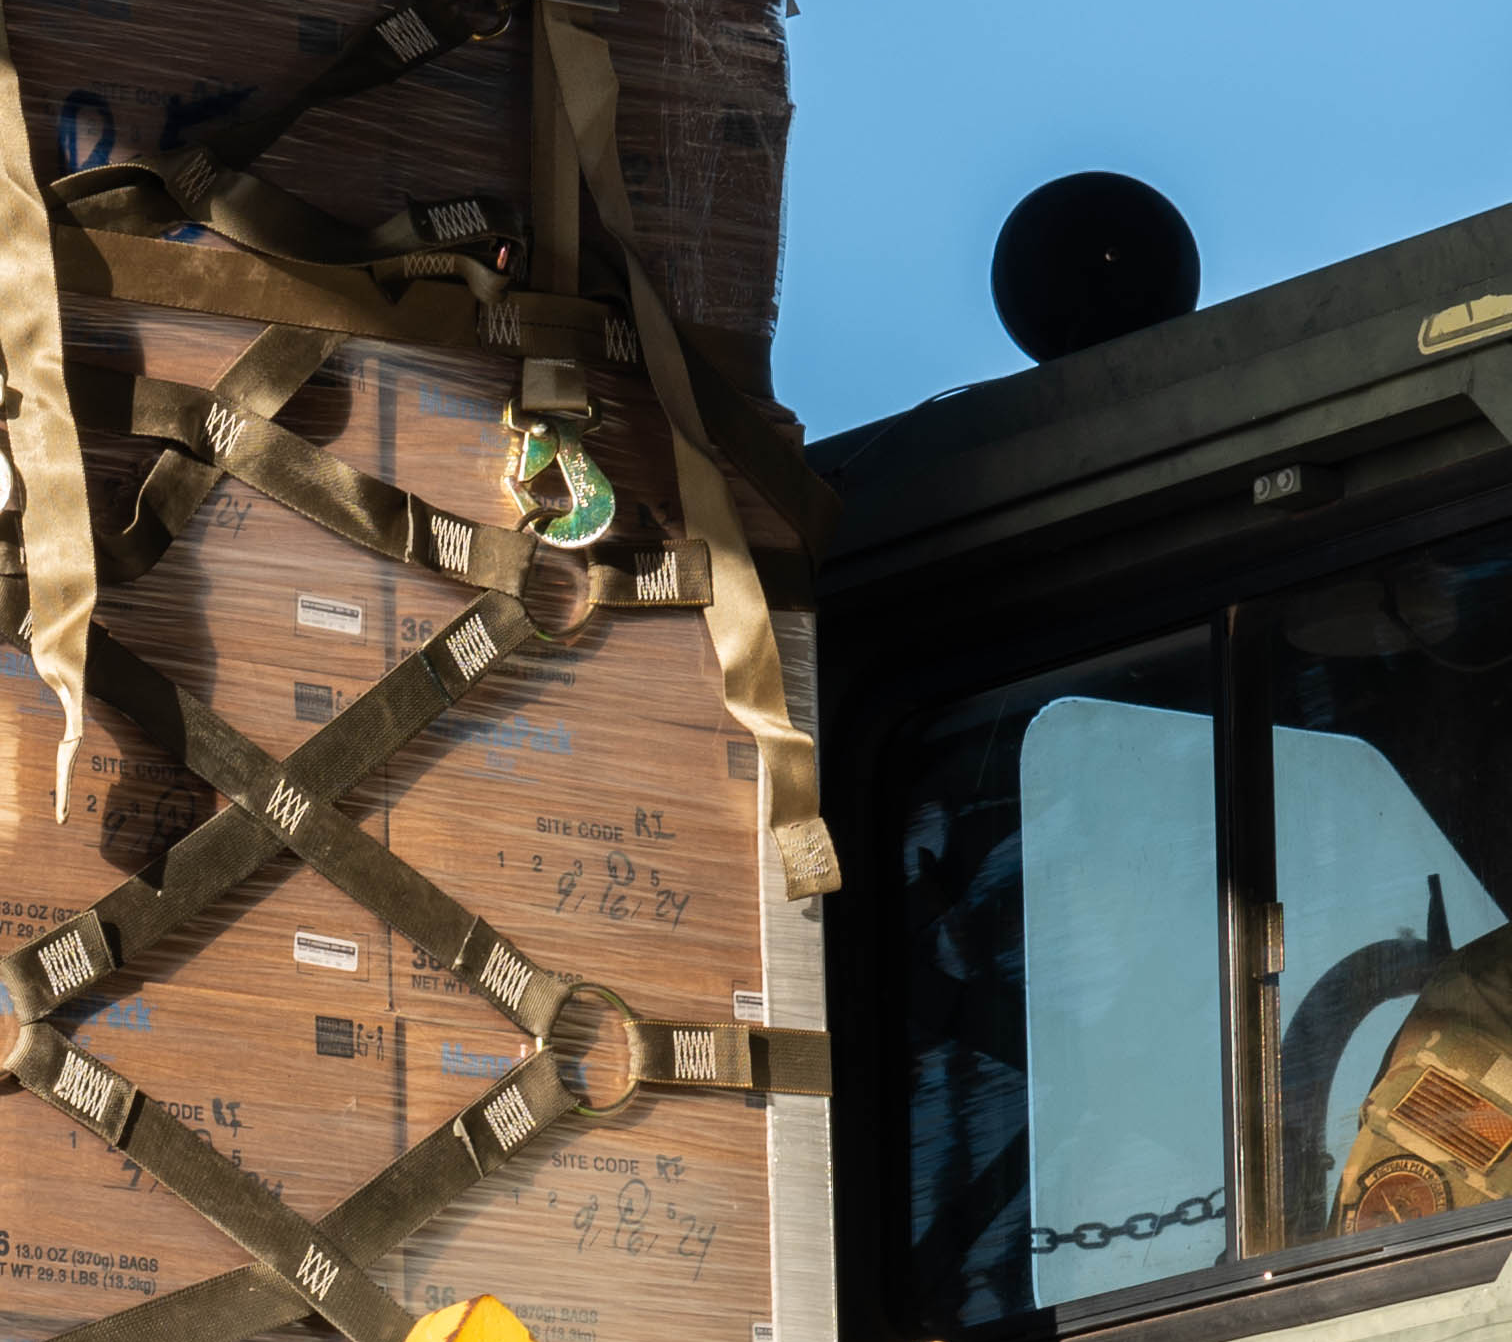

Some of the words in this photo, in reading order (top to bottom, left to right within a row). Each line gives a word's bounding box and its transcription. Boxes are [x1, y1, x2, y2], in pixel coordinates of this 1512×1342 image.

[86, 794, 98, 812] 2
[535, 816, 573, 837] SITE
[577, 819, 626, 842] CODE
[497, 850, 505, 869] 1
[531, 854, 543, 873] 2
[650, 869, 660, 887] 5
[26, 904, 50, 921] OZ
[411, 974, 441, 991] NET
[551, 1151, 589, 1172] SITE
[593, 1155, 640, 1177] CODE
[14, 1243, 44, 1259] 13.0
[46, 1246, 70, 1262] OZ
[72, 1248, 115, 1270] (370g)
[119, 1254, 159, 1273] BAGS
[10, 1263, 35, 1278] WT
[37, 1265, 68, 1283] 29.3
[70, 1268, 98, 1285] LBS
[103, 1273, 157, 1296] (13.3kg)
